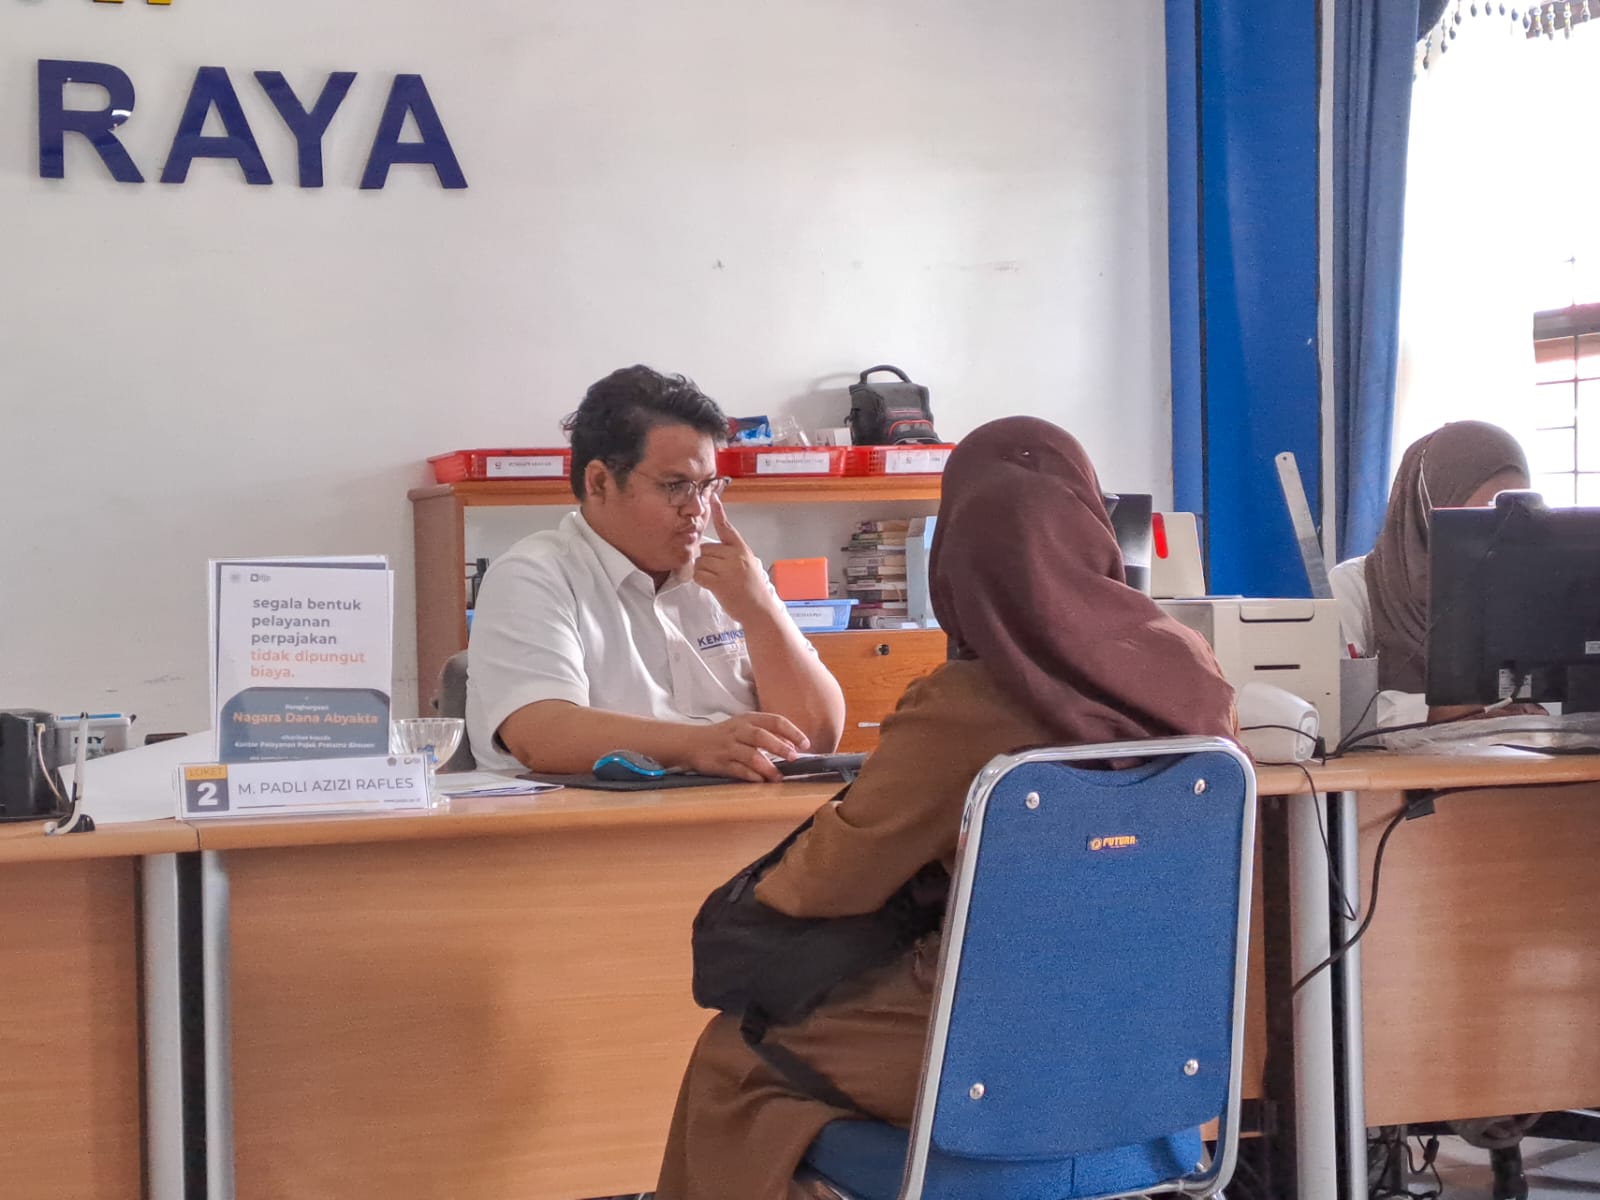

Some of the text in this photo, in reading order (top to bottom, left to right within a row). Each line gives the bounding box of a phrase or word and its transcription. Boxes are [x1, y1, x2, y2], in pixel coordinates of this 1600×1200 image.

[38, 59, 468, 189] RAYA
[252, 597, 361, 611] segala bentuk
[251, 614, 330, 628] pelayanan
[251, 632, 337, 646] perpajakan
[251, 648, 366, 664] tidak dipungut
[250, 665, 295, 679] biaya.
[232, 712, 379, 725] Nagara Dana Abyakta
[189, 767, 224, 777] LOKET
[238, 778, 414, 795] M. PADLI AZIZI RAFLES
[197, 782, 219, 806] 2
[1103, 835, 1136, 847] FUTURA
